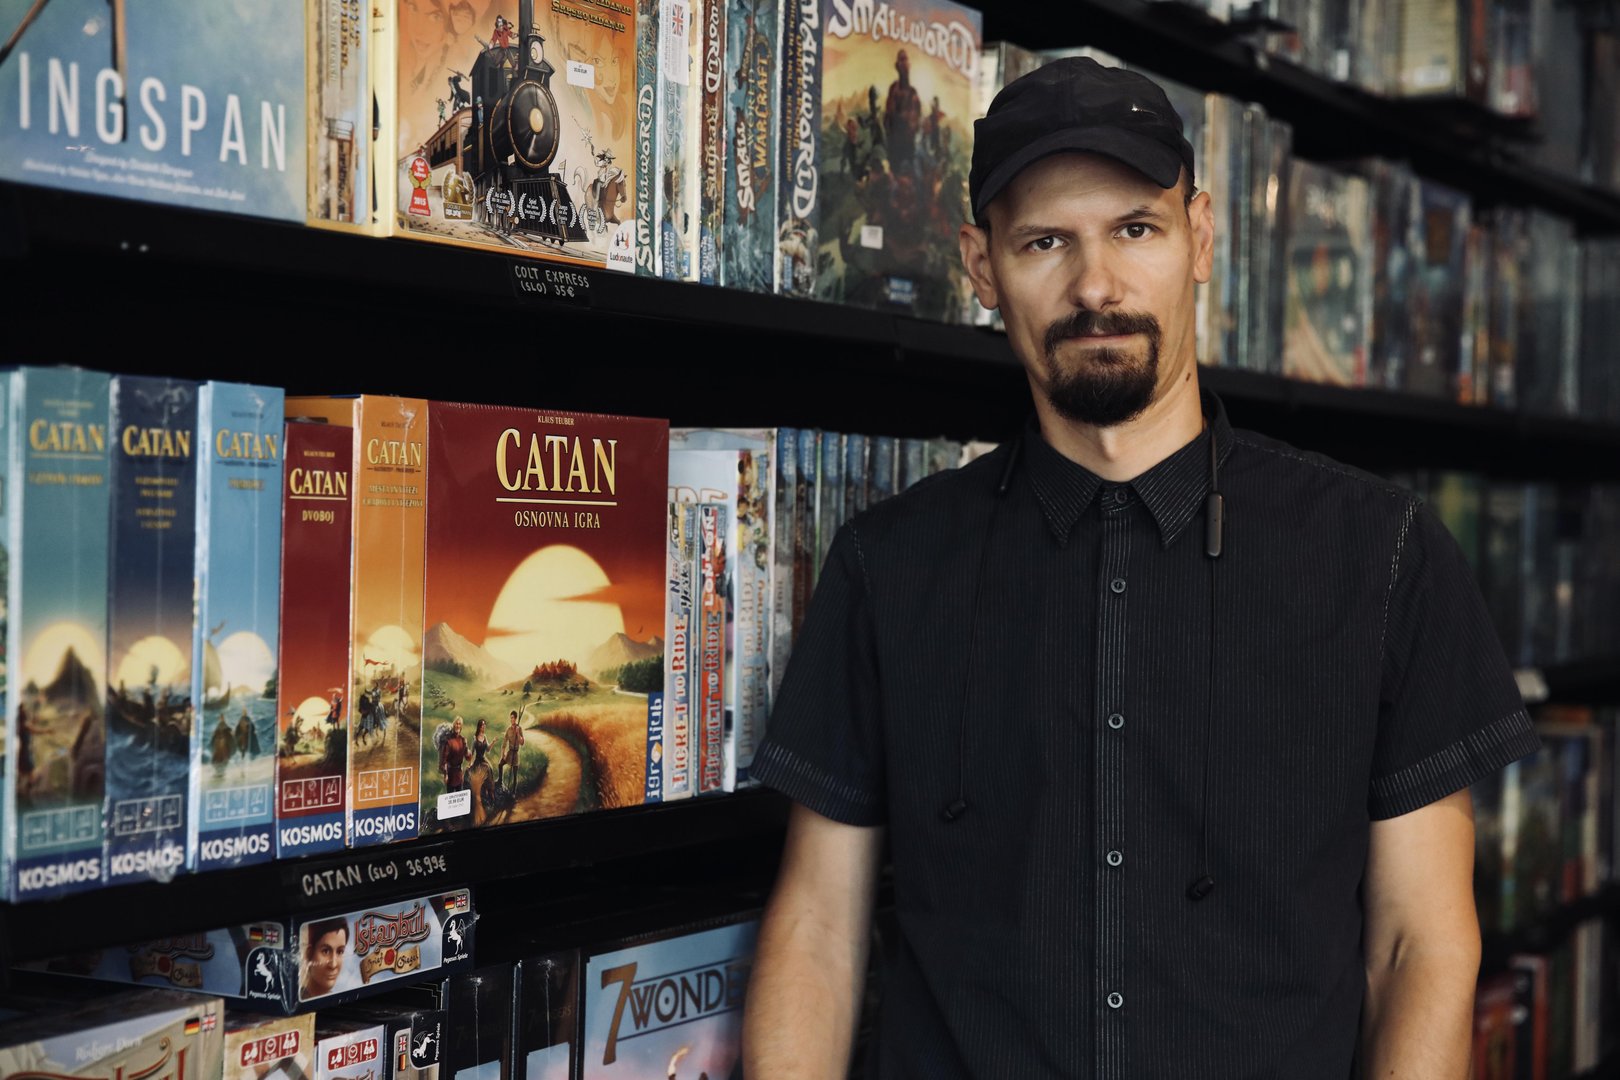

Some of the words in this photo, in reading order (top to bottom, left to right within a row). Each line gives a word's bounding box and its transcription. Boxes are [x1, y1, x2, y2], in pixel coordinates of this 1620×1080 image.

[19, 51, 287, 172] INGSPAN
[514, 265, 539, 280] COLT
[545, 270, 590, 288] EXPRESS
[520, 281, 547, 294] (SLO)
[555, 285, 575, 297] 35€
[29, 418, 105, 453] CATAN
[537, 415, 554, 424] KLAUS
[555, 417, 575, 426] TEUBER
[122, 424, 190, 457] CATAN
[215, 427, 278, 460] CATAN
[367, 438, 422, 467] CATAN
[496, 428, 618, 496] CATAN
[289, 467, 348, 496] CATAN
[302, 510, 335, 524] DVOBOJ
[514, 510, 569, 528] OSNOVNA
[574, 512, 601, 529] IGRA
[671, 613, 689, 673] RIDE
[703, 611, 721, 670] RIDE
[672, 701, 690, 787] TICKET
[281, 821, 342, 847] KOSMOS
[355, 812, 415, 838] KOSMOS
[111, 846, 184, 876] KOSMOS
[201, 833, 270, 861] KOSMOS
[18, 858, 100, 892] KOSMOS
[302, 864, 362, 896] CATAN
[367, 860, 399, 882] (SLO)
[406, 854, 447, 877] 36,99€
[354, 902, 431, 956] Istanbul
[601, 961, 638, 1066] 7
[628, 964, 751, 1031] WONDE
